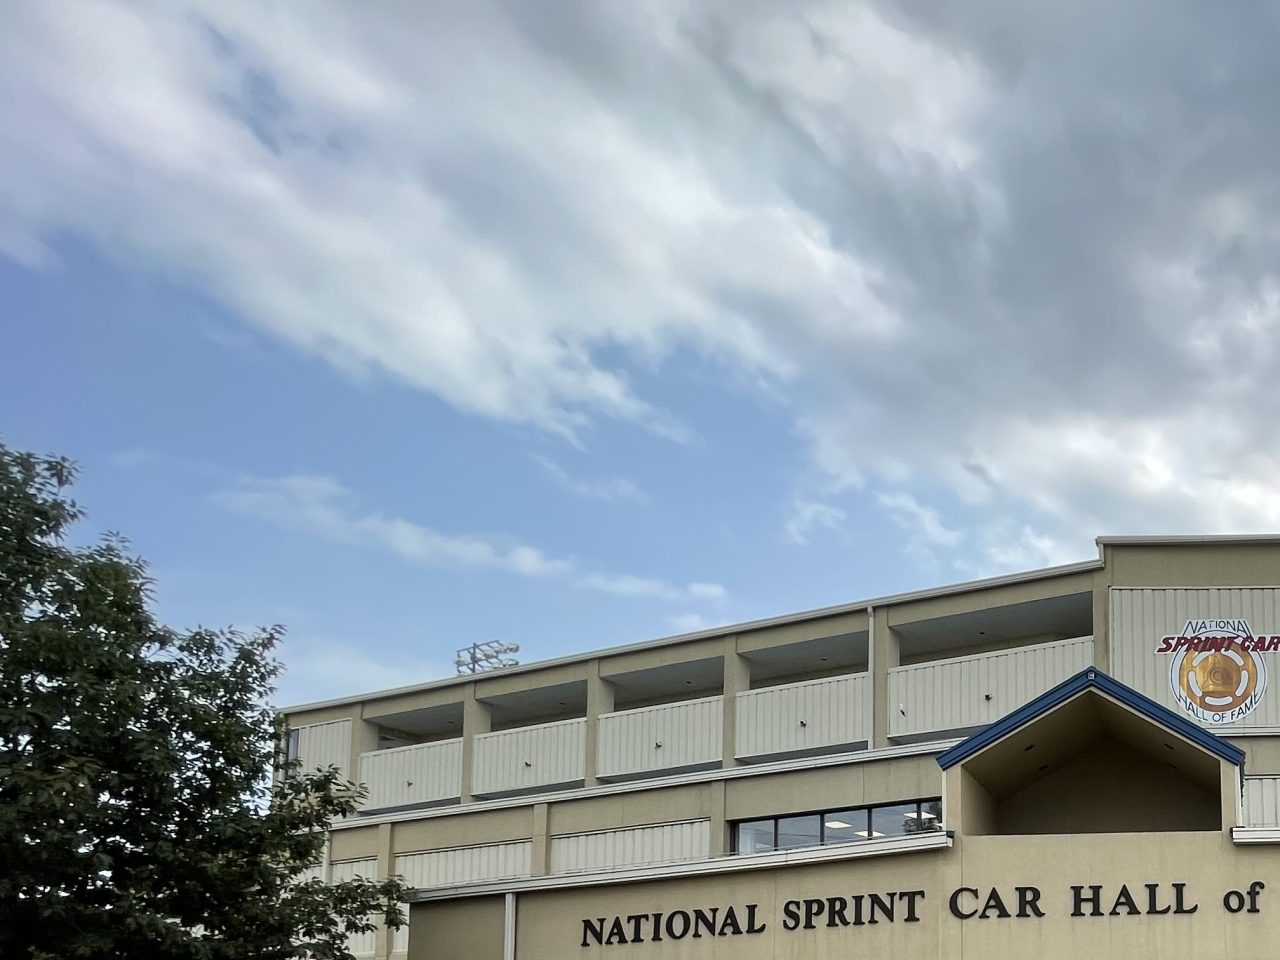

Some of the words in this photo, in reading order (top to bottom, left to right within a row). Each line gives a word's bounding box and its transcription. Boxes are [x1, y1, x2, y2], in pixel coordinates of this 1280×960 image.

[1183, 620, 1254, 636] NATIONAL
[1157, 636, 1237, 652] SPRINT
[1180, 694, 1208, 721] HALL
[1212, 713, 1227, 722] OF
[1231, 692, 1259, 721] FAME
[581, 904, 766, 948] NATIONAL
[782, 890, 925, 932] SPRINT
[949, 886, 1045, 920] CAR
[1070, 883, 1198, 917] HALL
[1223, 881, 1265, 914] of
